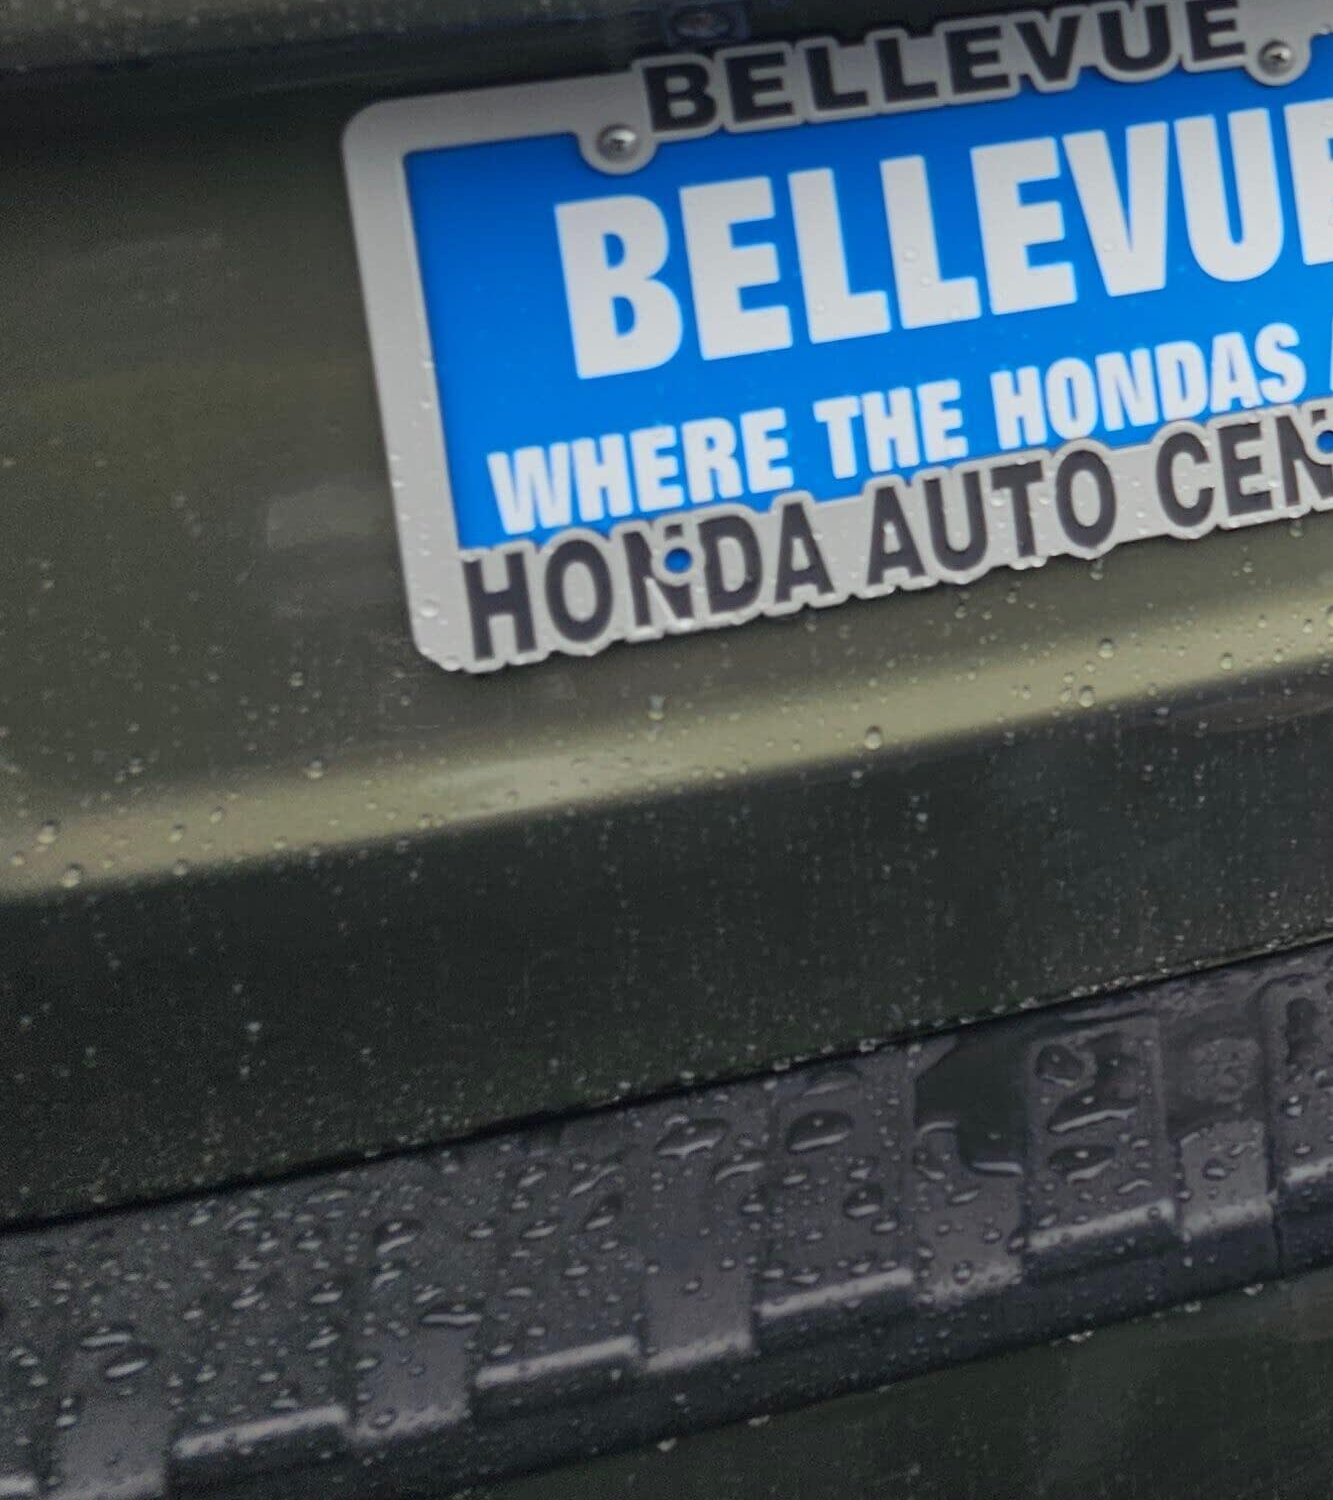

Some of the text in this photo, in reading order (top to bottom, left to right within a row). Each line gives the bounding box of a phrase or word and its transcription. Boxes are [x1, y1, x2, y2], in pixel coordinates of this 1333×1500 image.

[487, 407, 795, 536] WHERE
[813, 378, 970, 480] THE
[990, 322, 1308, 451] HONDAS
[463, 501, 835, 661] HONDA
[866, 449, 1117, 586] AUTO
